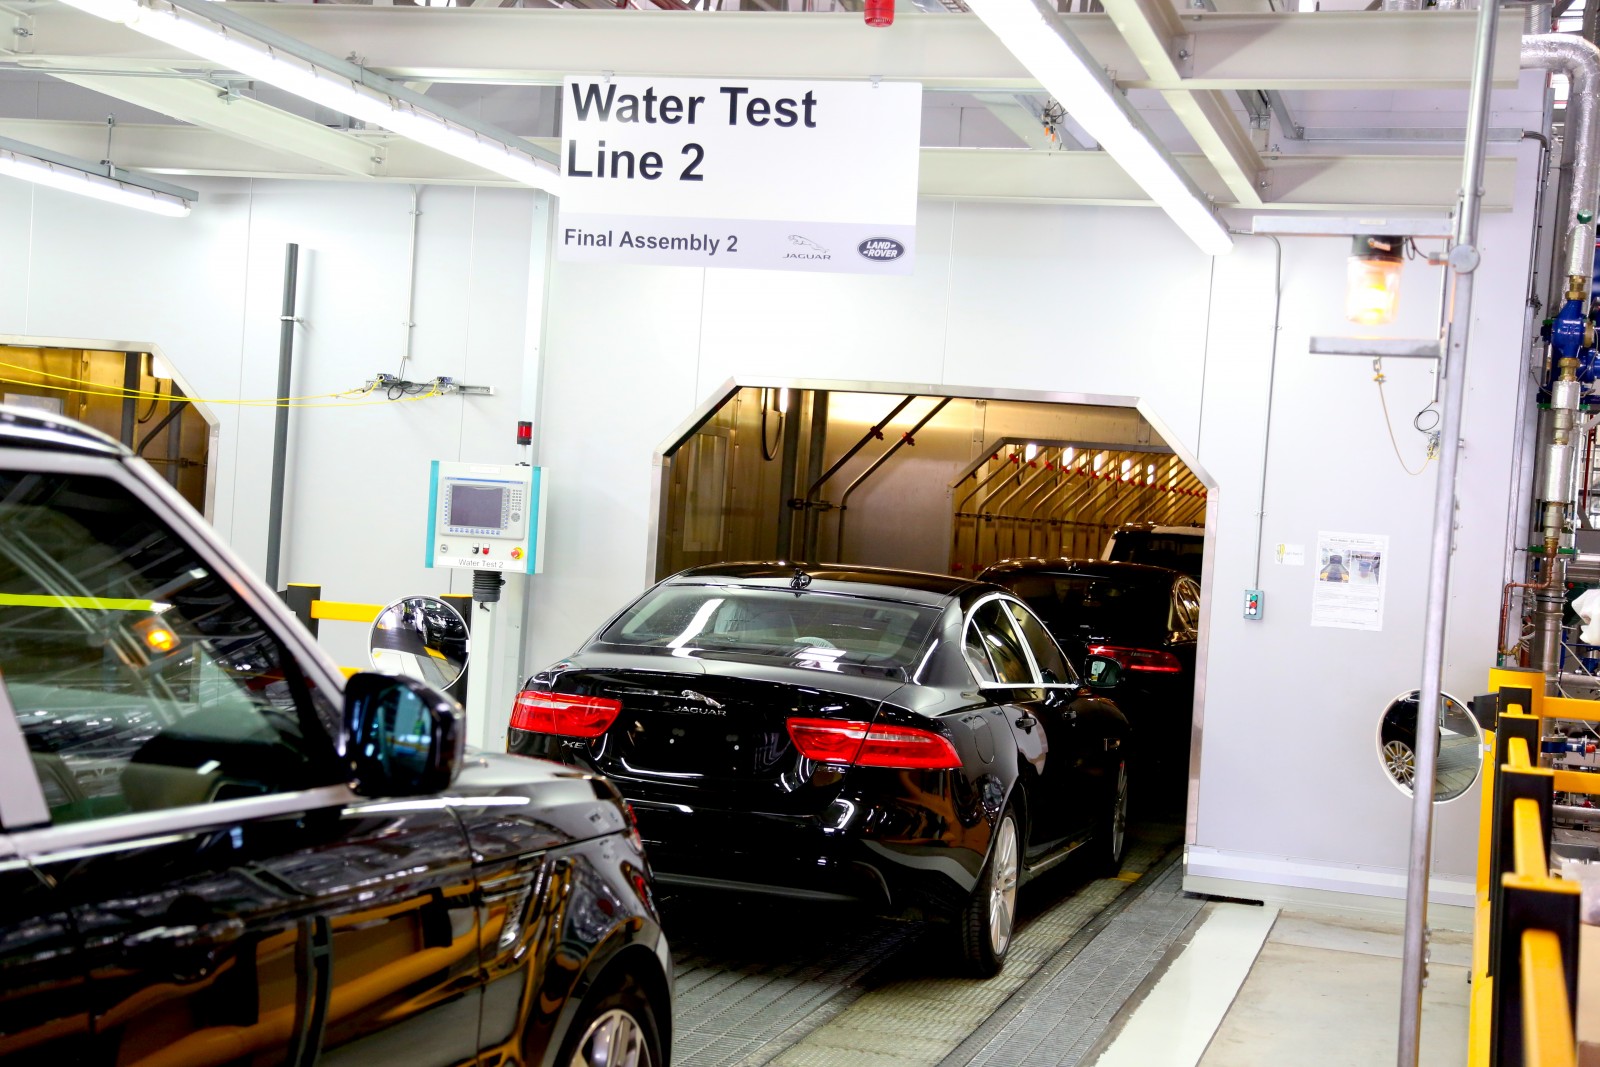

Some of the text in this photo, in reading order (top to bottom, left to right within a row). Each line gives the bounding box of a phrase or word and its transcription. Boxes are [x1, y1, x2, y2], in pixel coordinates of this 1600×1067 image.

[572, 83, 817, 128] Water Test
[567, 139, 705, 181] Line 2
[564, 228, 738, 256] Final Assembly 2
[866, 241, 891, 249] LAND
[867, 249, 898, 258] ROVER
[459, 559, 480, 567] Water
[482, 560, 497, 568] Test
[673, 706, 727, 717] JAGUAR
[561, 740, 586, 749] XE
